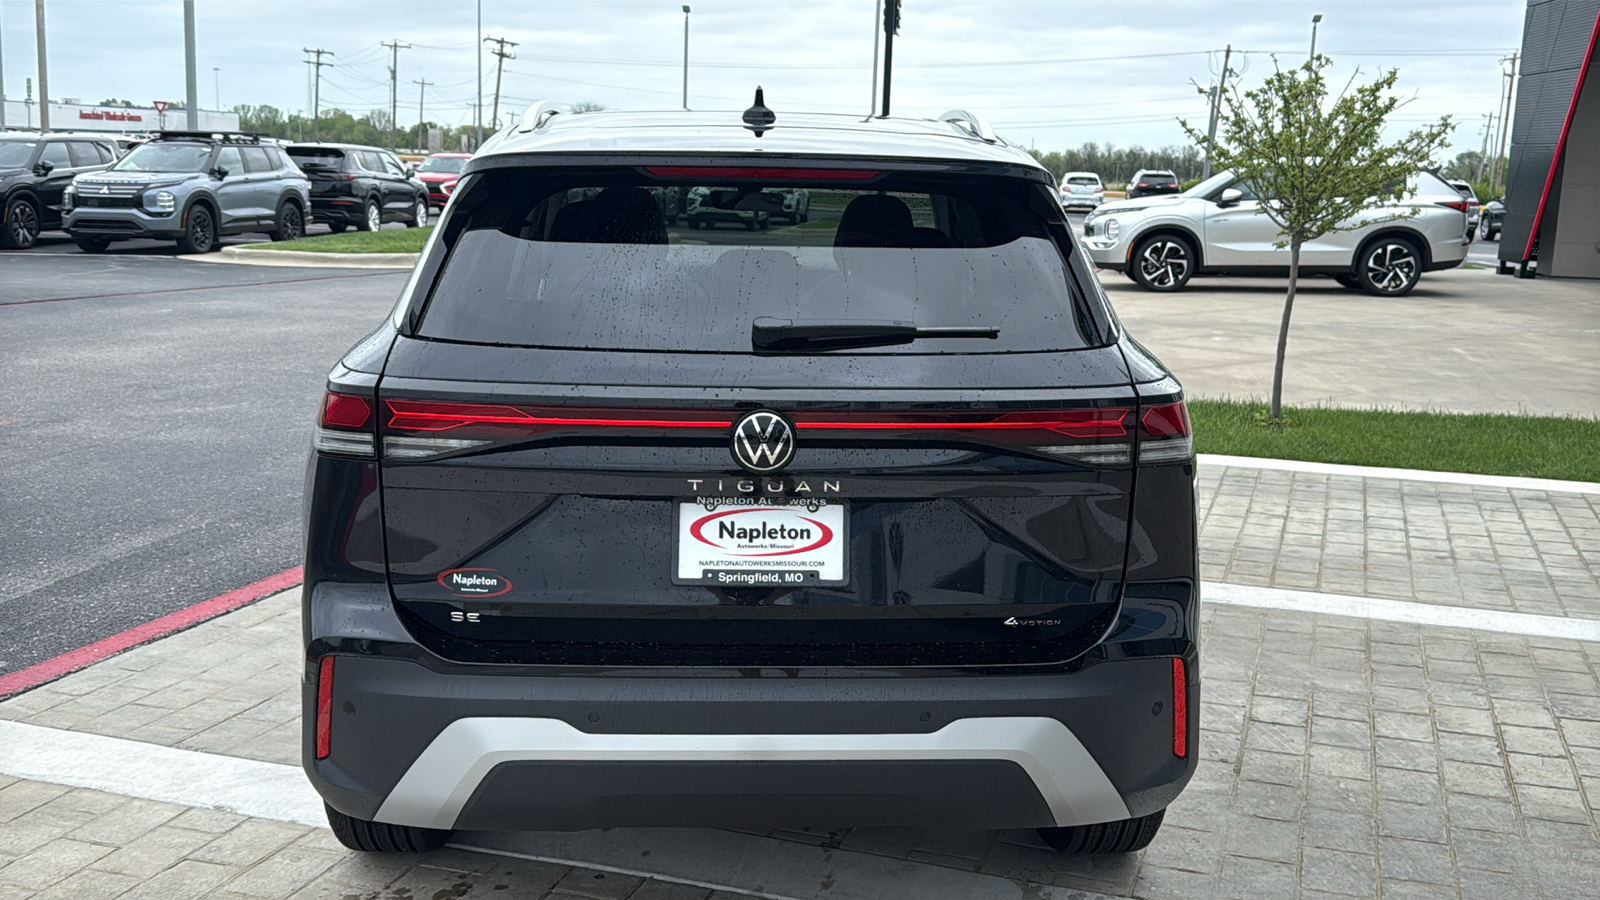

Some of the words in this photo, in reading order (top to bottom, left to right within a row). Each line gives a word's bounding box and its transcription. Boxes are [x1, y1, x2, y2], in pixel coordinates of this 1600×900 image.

[687, 480, 840, 492] TIGUAN
[697, 497, 754, 506] Napleton
[719, 521, 811, 543] Napleton
[452, 573, 497, 586] Napleton
[718, 572, 782, 584] Springfield,
[785, 573, 804, 582] MO
[450, 611, 481, 622] SE
